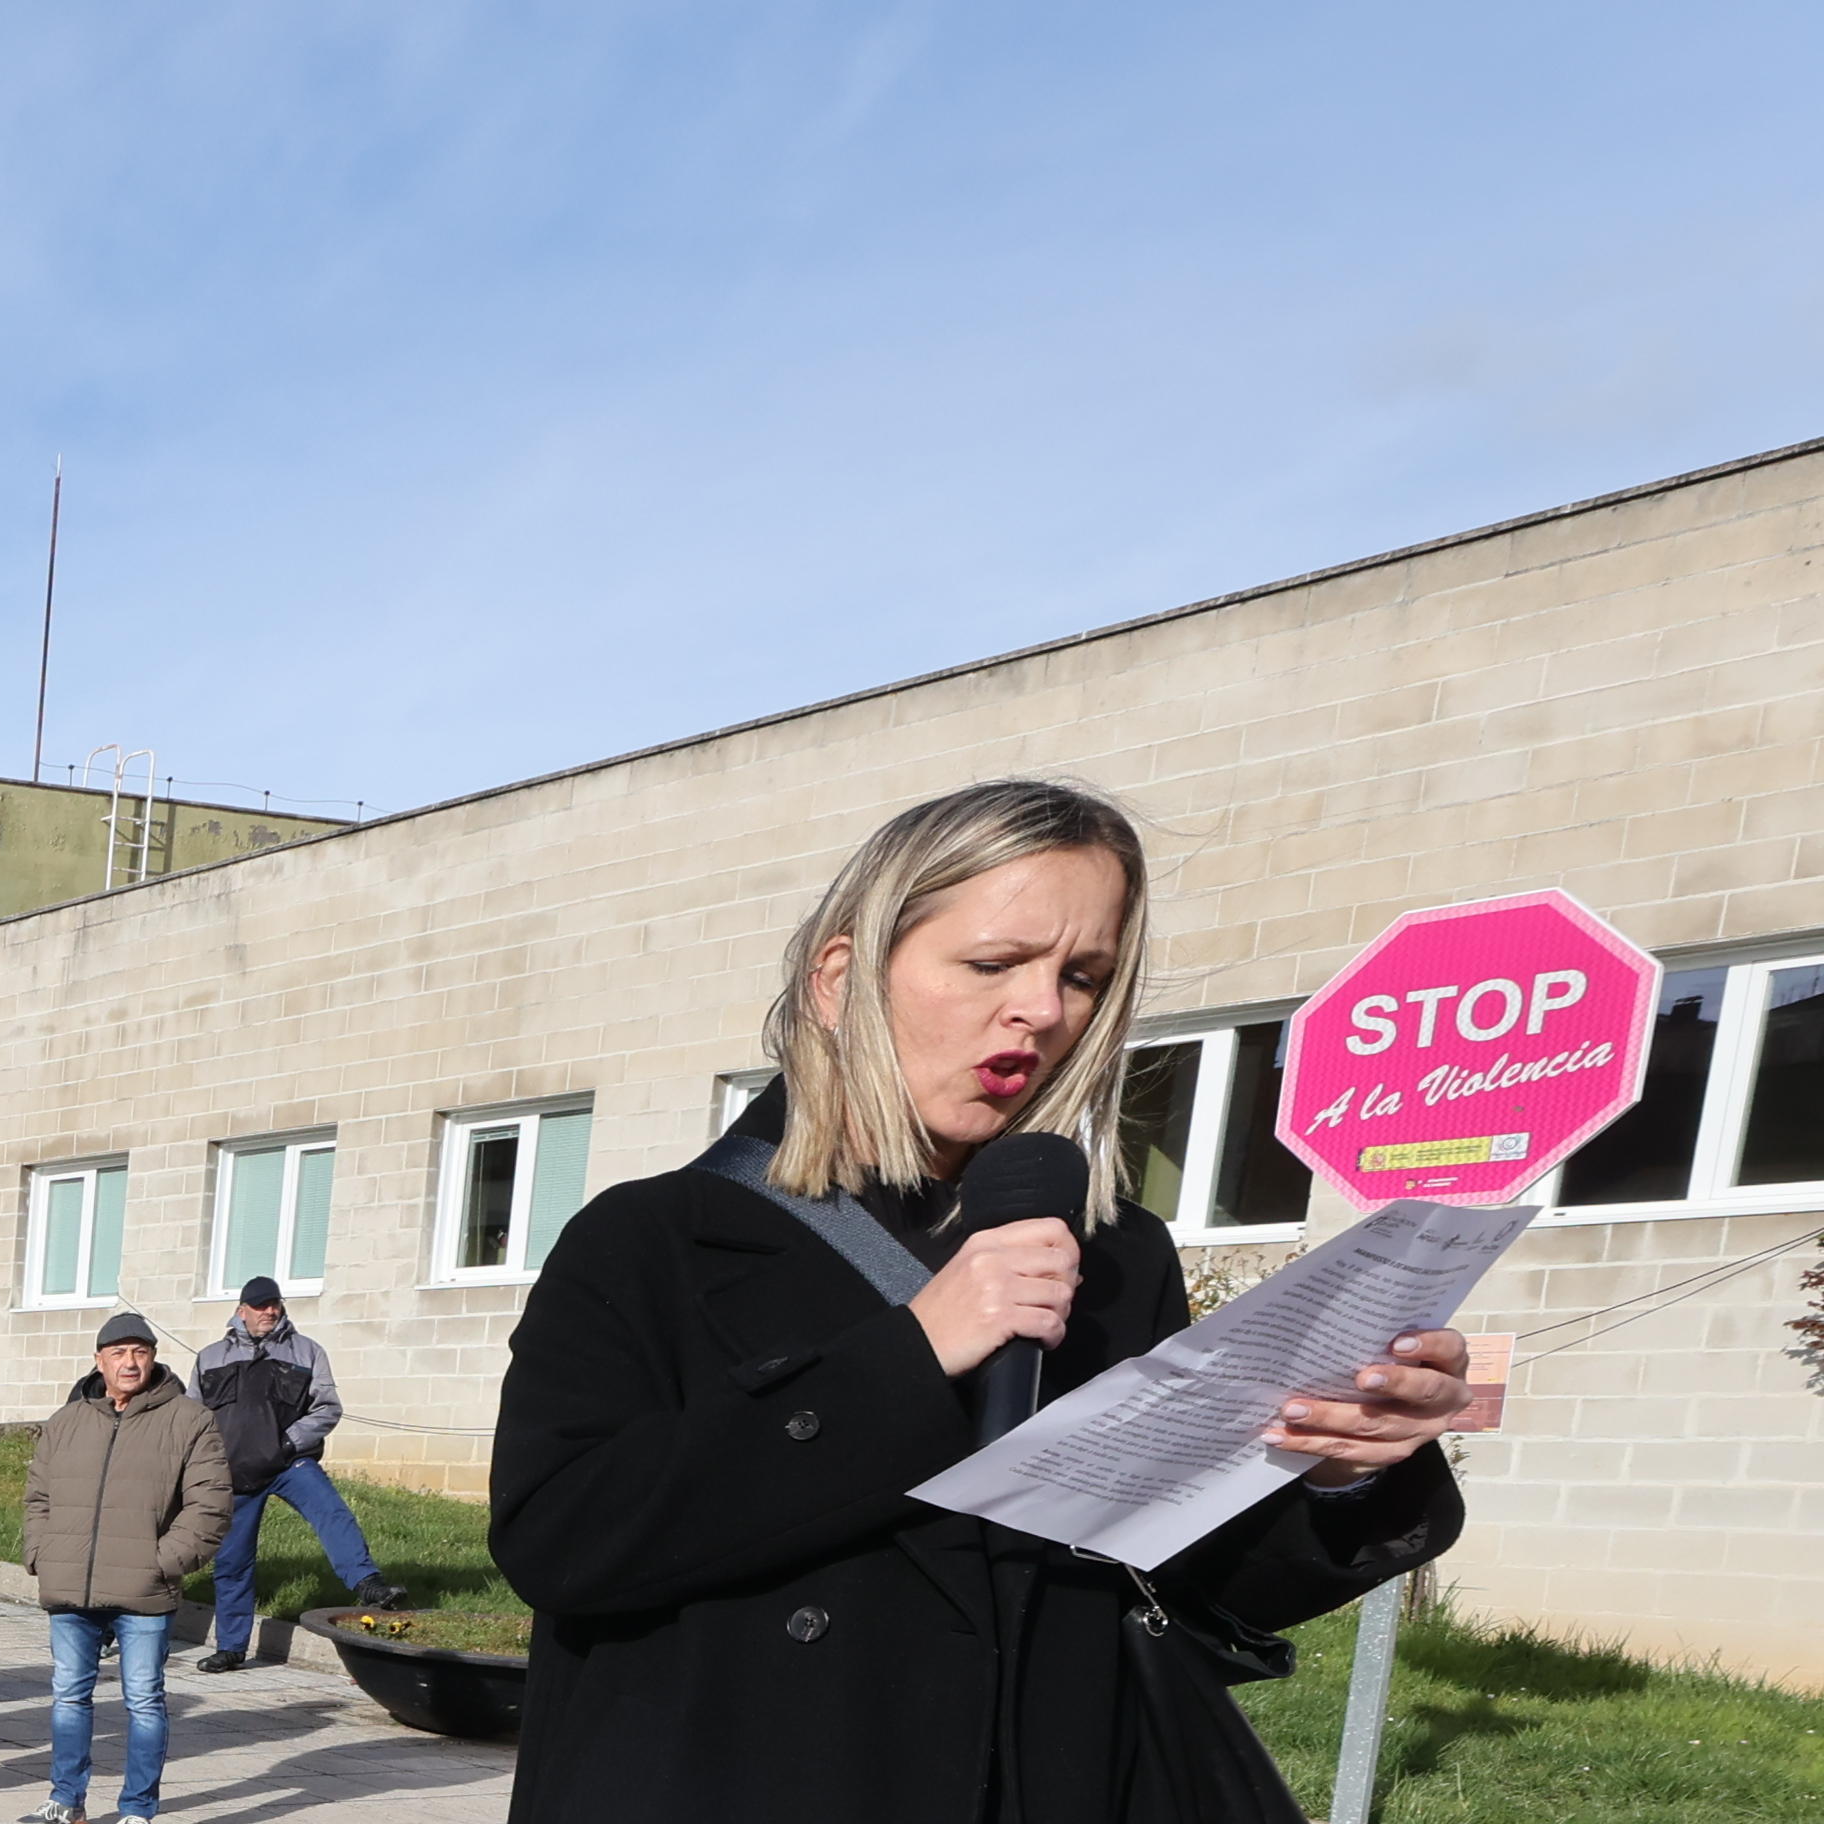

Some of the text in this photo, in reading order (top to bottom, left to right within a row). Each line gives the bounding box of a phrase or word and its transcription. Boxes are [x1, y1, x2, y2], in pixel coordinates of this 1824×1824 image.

[1344, 969, 1588, 1056] STOP
[1305, 1040, 1616, 1135] A la Violencia
